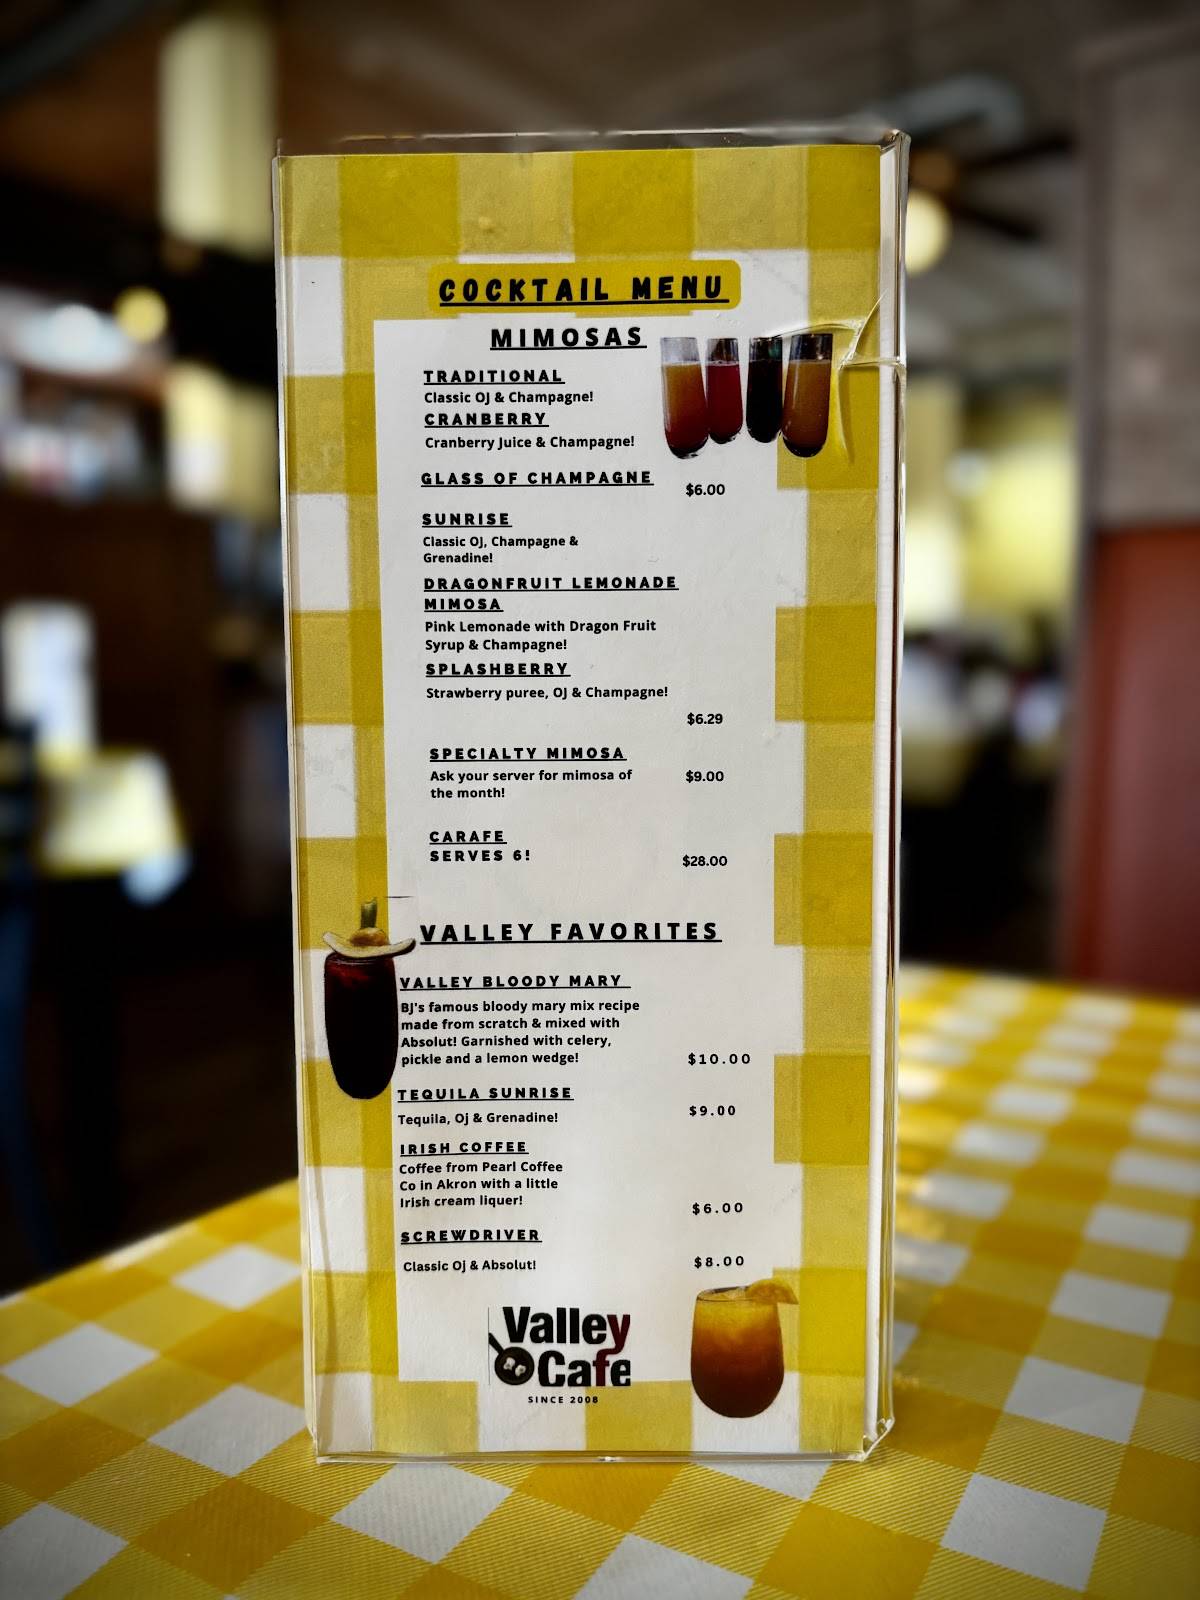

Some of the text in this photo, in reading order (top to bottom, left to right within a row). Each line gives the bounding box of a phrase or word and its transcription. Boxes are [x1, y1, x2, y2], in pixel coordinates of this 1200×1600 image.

[439, 276, 723, 302] COCKTAIL MENU
[491, 328, 642, 347] MIMOSAS
[424, 370, 562, 382] TRADITIONAL
[424, 391, 593, 405] Classic OJ & Champagne!
[425, 413, 546, 426] CRANBERRY
[425, 435, 634, 451] Cranberry Juice & Champagne!
[421, 471, 651, 485] GLASS OF CHAMPAGNE
[686, 483, 725, 497] $6.00
[422, 513, 510, 526] SUNRISE
[423, 535, 579, 549] Classic OJ, Champagne &
[423, 552, 493, 563] Grenadine!
[424, 576, 677, 590] DRAGONFRUIT LEMONADE
[424, 598, 501, 610] MIMOSA
[425, 620, 656, 634] Pink Lemonade with Dragon Fruit
[425, 639, 567, 653] Syrup & Champagne!
[426, 663, 568, 675] SPLASHBERRY
[427, 686, 668, 701] Strawberry puree, OJ & Champagne!
[687, 712, 723, 726] $6.29
[430, 748, 624, 760] SPECIALTY MIMOSA
[430, 769, 633, 784] Ask your server for mimosa of
[686, 770, 724, 783] $9.00
[431, 788, 505, 798] the month!
[430, 831, 504, 842] CARAFE
[430, 851, 503, 862] SERVES
[682, 855, 727, 868] $28.00
[420, 922, 718, 941] VALLEY FAVORITES
[400, 975, 621, 989] VALLEY BLOODY MARY
[401, 1000, 640, 1014] BJ's famous bloody mary mix recipe
[401, 1017, 620, 1030] made from scratch & mixed with
[401, 1035, 611, 1048] Absolut! Garnished with celery,
[401, 1052, 579, 1067] pickle and a lemon wedge!
[688, 1053, 751, 1066] $10.00
[398, 1087, 571, 1102] TEQUILA SUNRISE
[689, 1104, 736, 1118] $9.00
[398, 1113, 451, 1127] Tequila,
[473, 1112, 482, 1123] &
[486, 1112, 558, 1123] Grenadine!
[400, 1142, 527, 1155] IRISH COFFEE
[399, 1161, 563, 1174] Coffee from Pearl Coffee
[399, 1178, 558, 1191] Co in Akron with a little
[400, 1195, 523, 1209] Irish cream liquer!
[691, 1202, 743, 1215] $6.00
[401, 1229, 540, 1243] SCREWDRIVER
[403, 1261, 449, 1273] Classic
[470, 1260, 479, 1270] &
[482, 1259, 536, 1270] Absolut!
[694, 1256, 745, 1269] $8.00
[502, 1307, 630, 1351] Valley
[537, 1349, 631, 1387] Cafe
[528, 1395, 599, 1404] SINCE 2008
